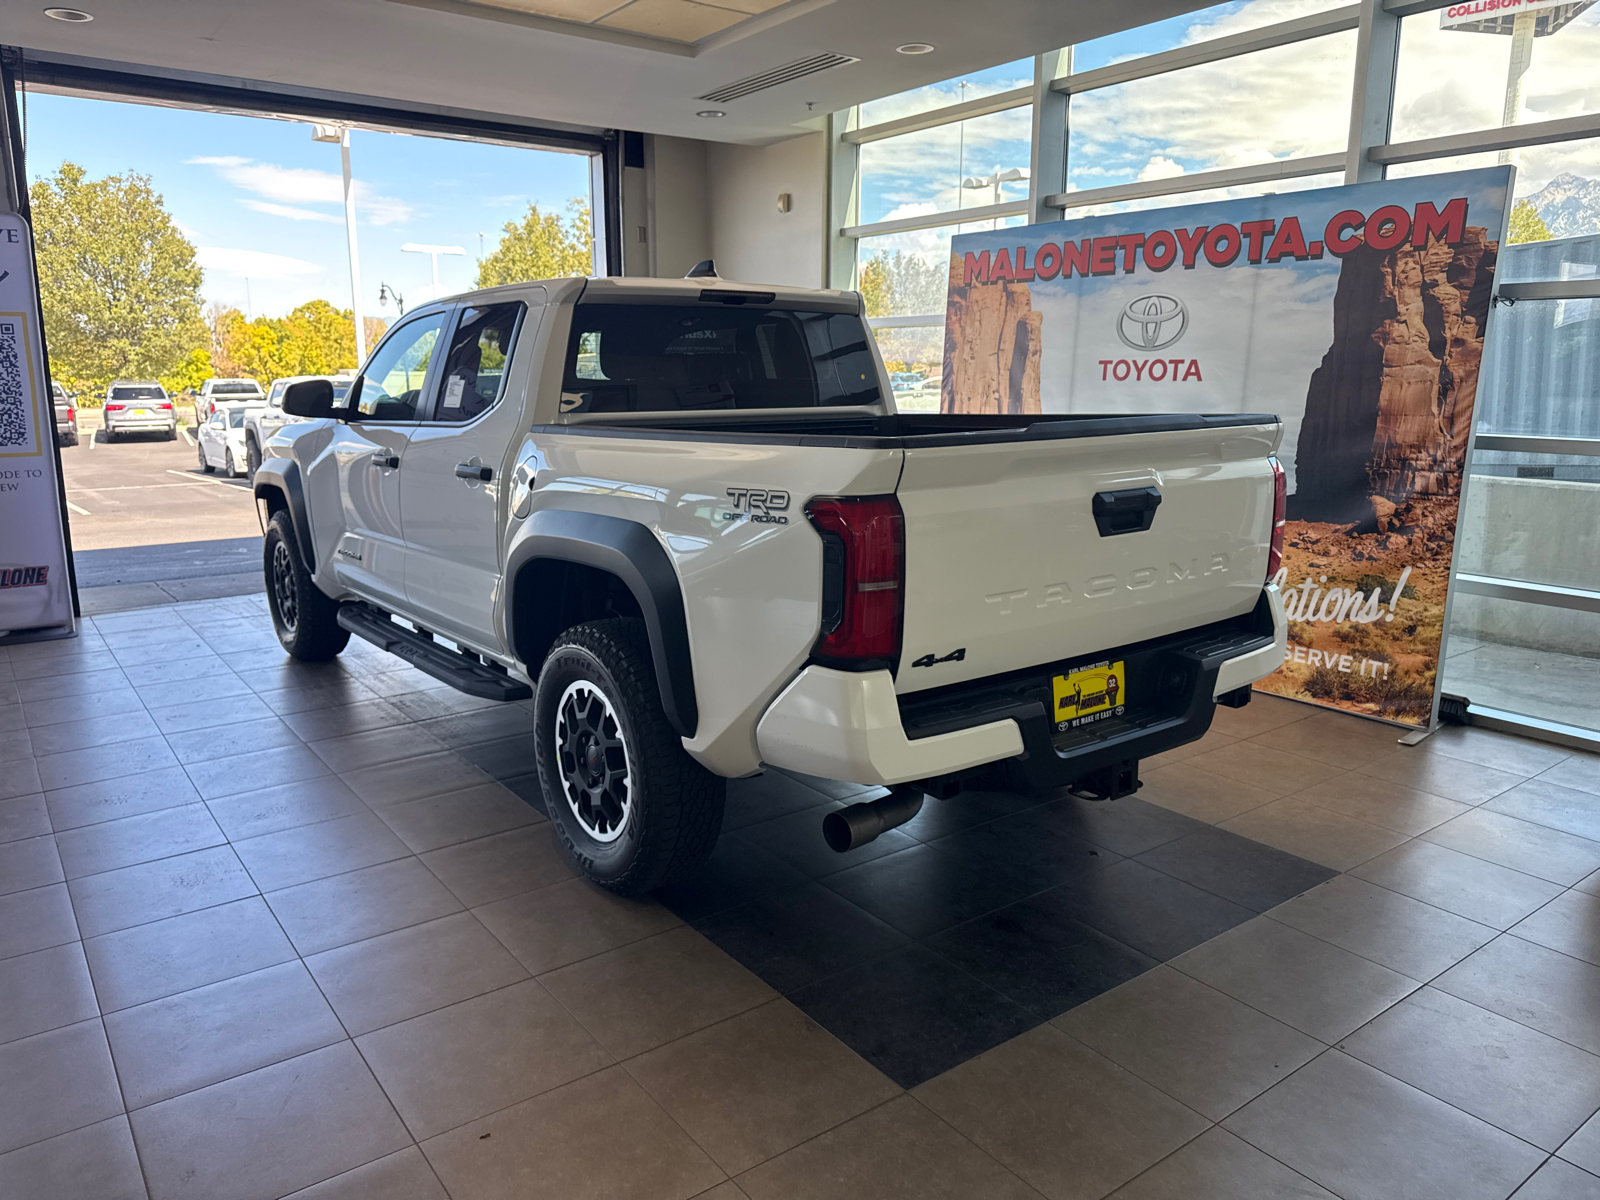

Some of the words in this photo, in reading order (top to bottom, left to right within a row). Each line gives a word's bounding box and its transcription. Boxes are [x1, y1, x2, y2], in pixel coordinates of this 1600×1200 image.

[963, 197, 1469, 286] MALONETOYOTA.COM
[1098, 358, 1203, 383] TOYOTA
[24, 469, 42, 478] TO
[726, 487, 791, 515] TRD
[751, 514, 789, 525] ROAD
[985, 553, 1230, 616] TACOMA
[1359, 658, 1389, 680] IT!
[1108, 679, 1116, 687] 32
[1071, 718, 1080, 727] WE
[1080, 714, 1094, 725] MAKE
[1094, 713, 1100, 721] IT
[1100, 709, 1112, 720] EASY
